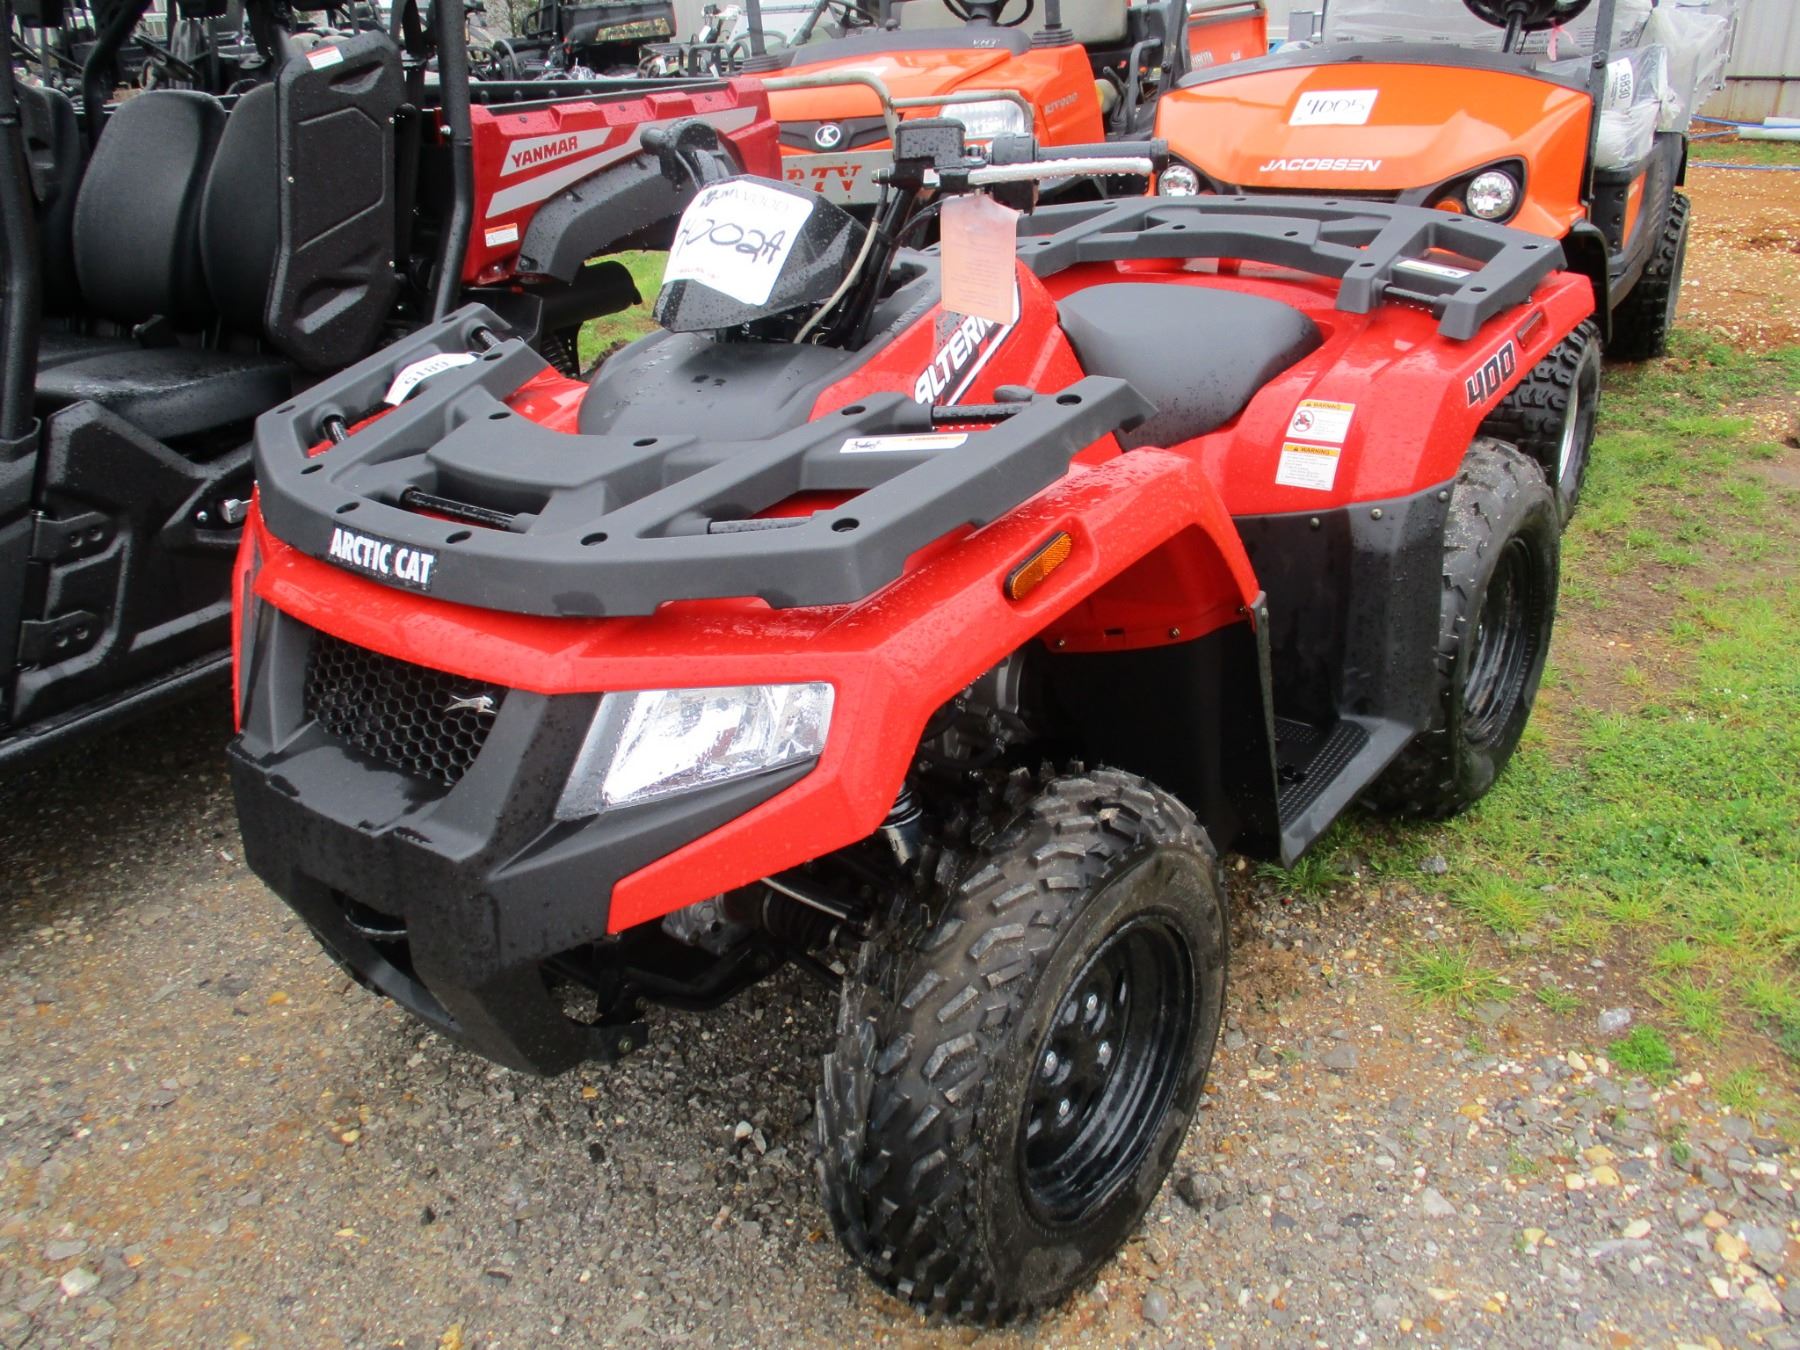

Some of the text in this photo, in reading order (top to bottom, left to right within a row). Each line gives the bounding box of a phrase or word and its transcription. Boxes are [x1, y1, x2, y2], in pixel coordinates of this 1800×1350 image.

[511, 135, 578, 168] YANMAR
[1260, 158, 1382, 172] JACOBSEN
[1465, 339, 1516, 408] 400
[1313, 402, 1342, 411] WARNING
[1301, 446, 1330, 456] WARNING
[329, 527, 434, 584] ARCTIC CAT
